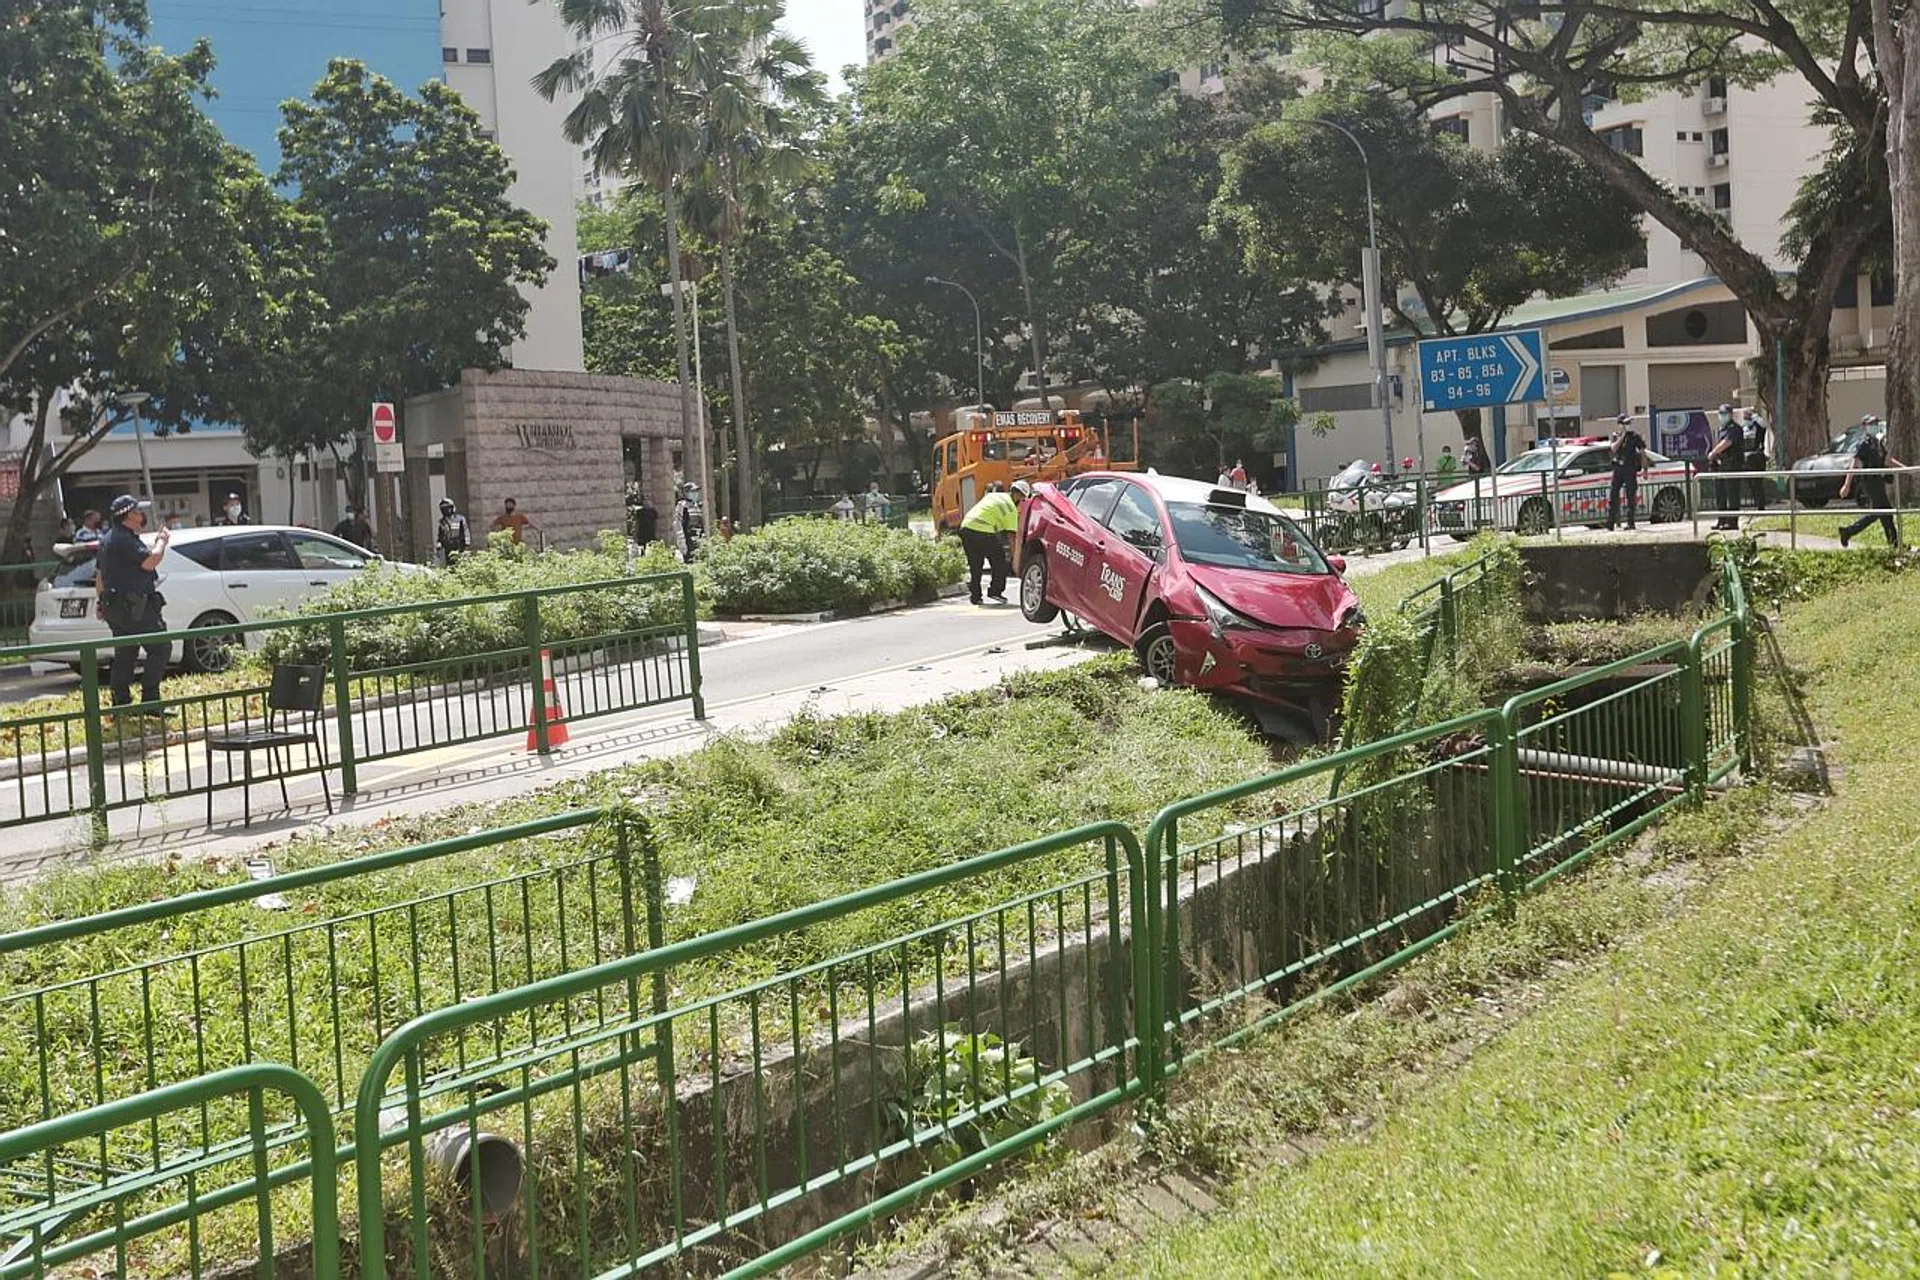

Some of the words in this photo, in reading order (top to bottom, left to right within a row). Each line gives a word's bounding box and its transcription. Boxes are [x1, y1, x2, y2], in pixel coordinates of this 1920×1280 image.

[1436, 349, 1461, 363] APT.
[1467, 345, 1497, 361] BLKS
[996, 413, 1016, 426] EMAS
[1017, 412, 1051, 424] RECOVERY
[1100, 562, 1126, 591] TRANS
